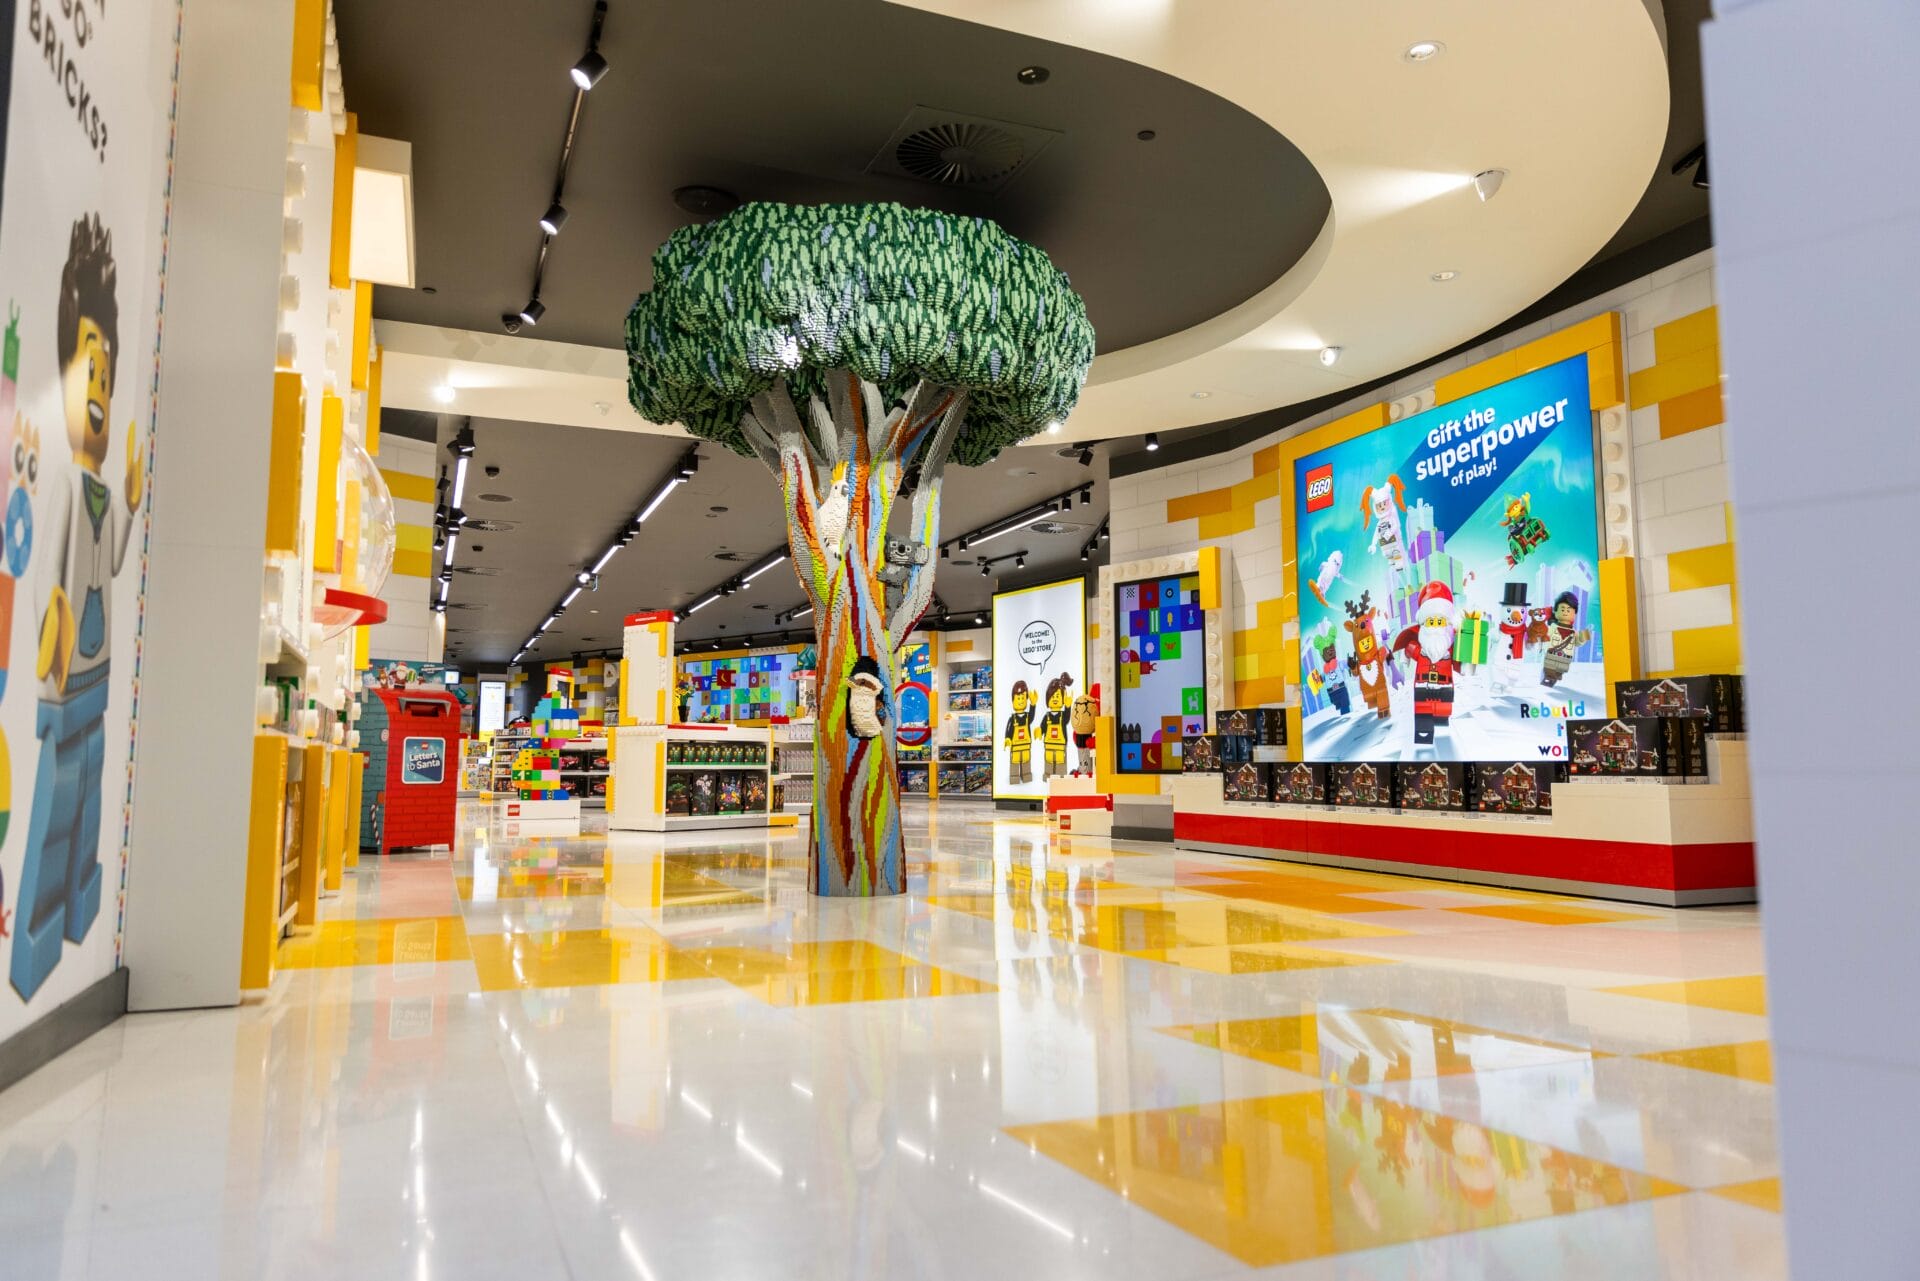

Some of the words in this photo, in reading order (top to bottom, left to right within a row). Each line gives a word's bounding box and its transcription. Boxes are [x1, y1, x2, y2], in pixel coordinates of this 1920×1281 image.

[29, 0, 108, 164] BRICKS?
[1415, 397, 1569, 481] superpower
[1427, 419, 1462, 449] Gift
[1463, 407, 1496, 432] the
[1450, 472, 1464, 487] of
[1465, 457, 1498, 485] play!
[1307, 476, 1332, 501] LEGO
[1024, 629, 1050, 639] WELCOME!
[1520, 700, 1586, 719] Rebuild
[407, 763, 415, 771] to
[416, 759, 440, 769] Santa
[410, 752, 438, 761] Letters
